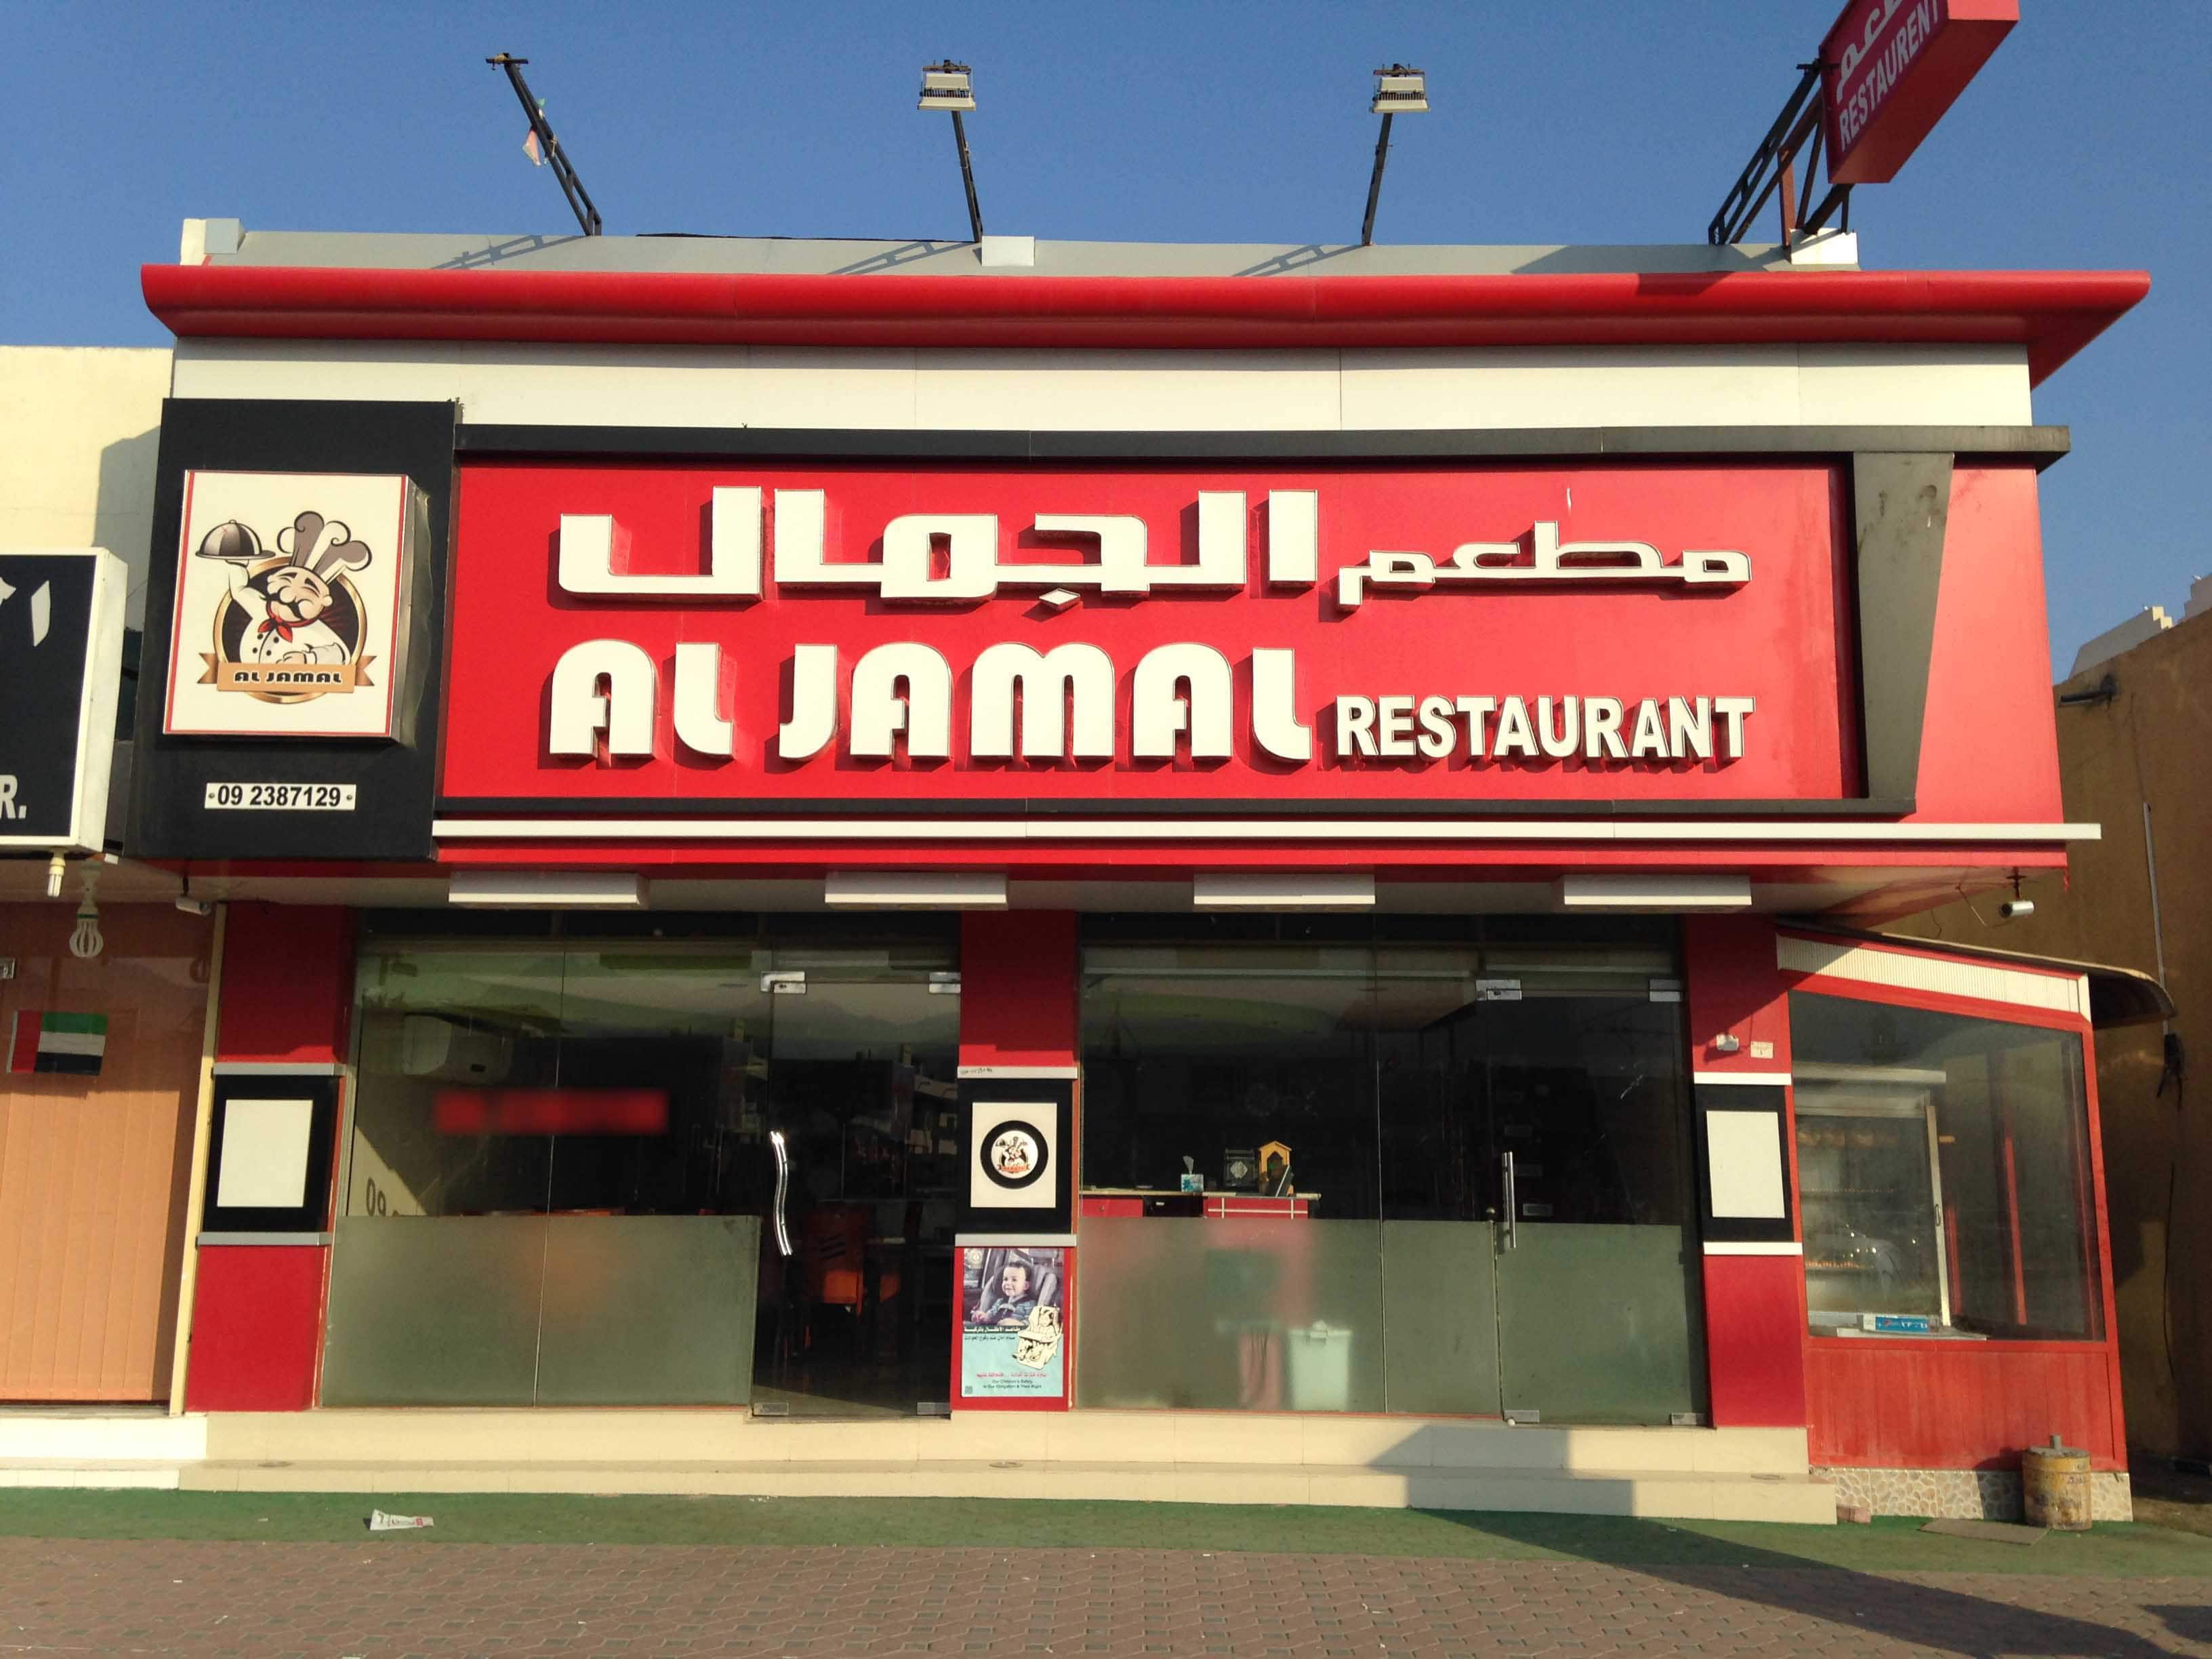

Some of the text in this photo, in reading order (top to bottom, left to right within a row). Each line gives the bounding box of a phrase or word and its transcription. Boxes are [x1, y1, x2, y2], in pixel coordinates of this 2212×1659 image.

[558, 485, 1752, 613] مطعم الجمال
[234, 672, 342, 683] AL JAMAL
[549, 638, 1757, 762] AL JAMAL RESTAURANT
[218, 785, 341, 807] 09 2387129
